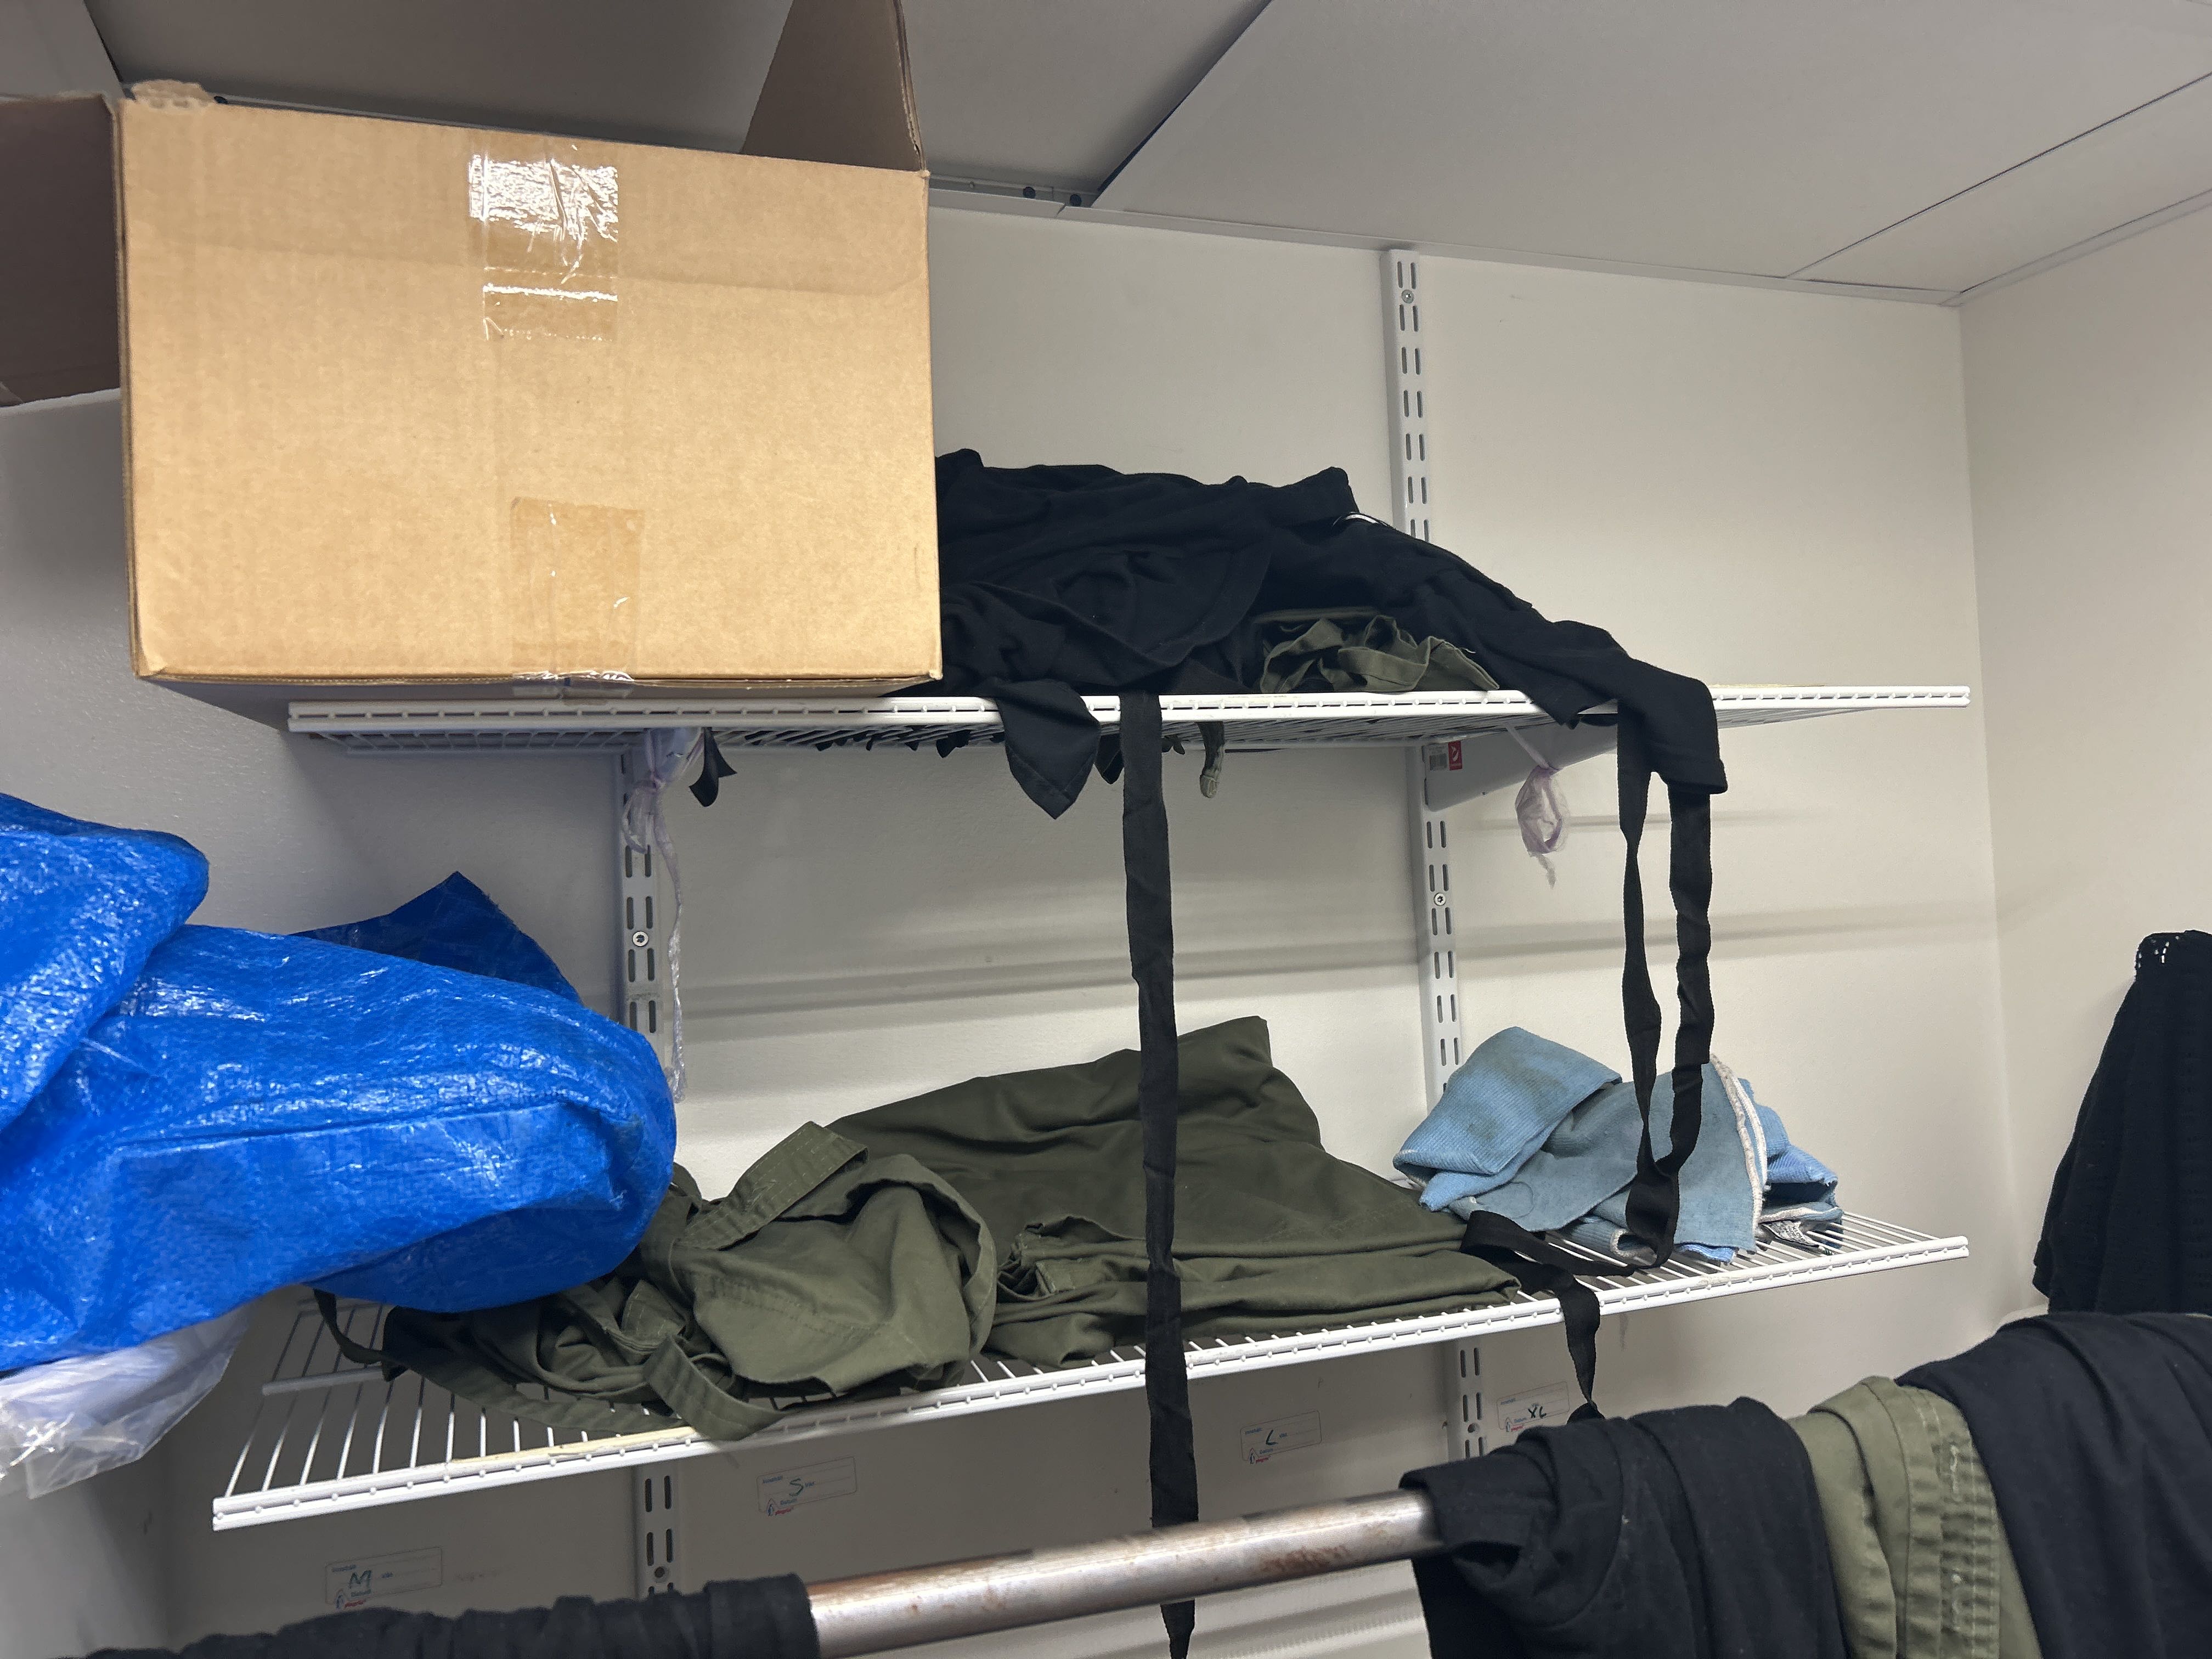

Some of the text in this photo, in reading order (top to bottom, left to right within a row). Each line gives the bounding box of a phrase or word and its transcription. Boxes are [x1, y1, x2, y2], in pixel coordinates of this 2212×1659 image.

[1528, 1406, 1547, 1419] XL
[1266, 1430, 1278, 1446] L
[789, 1477, 804, 1497] S
[348, 1570, 372, 1589] M
